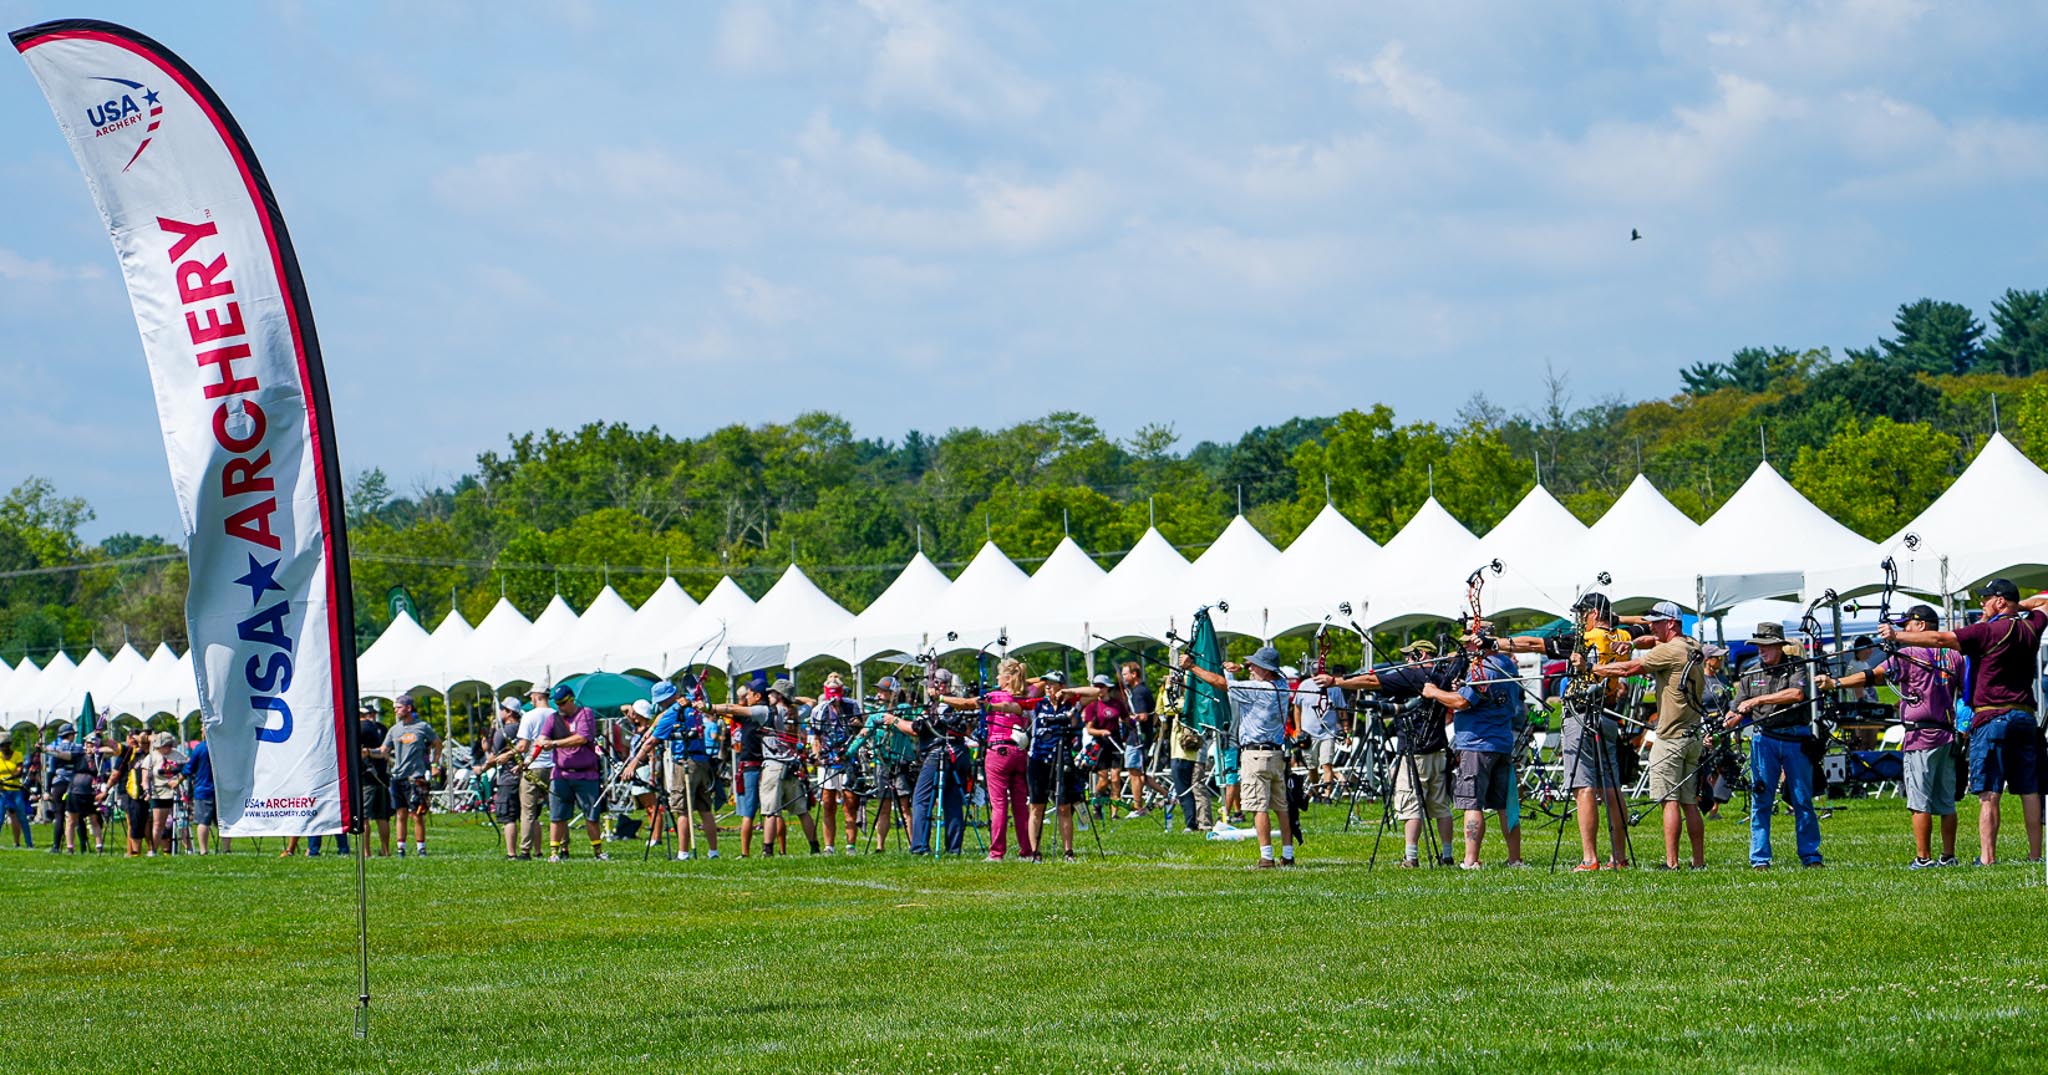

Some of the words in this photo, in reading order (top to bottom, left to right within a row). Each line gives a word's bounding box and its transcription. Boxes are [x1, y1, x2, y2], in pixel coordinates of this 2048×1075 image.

[86, 94, 140, 128] USA
[95, 113, 143, 138] ARCHERY
[156, 216, 282, 552] ARCHERY
[237, 600, 294, 744] USA
[265, 797, 317, 809] ARCHERY
